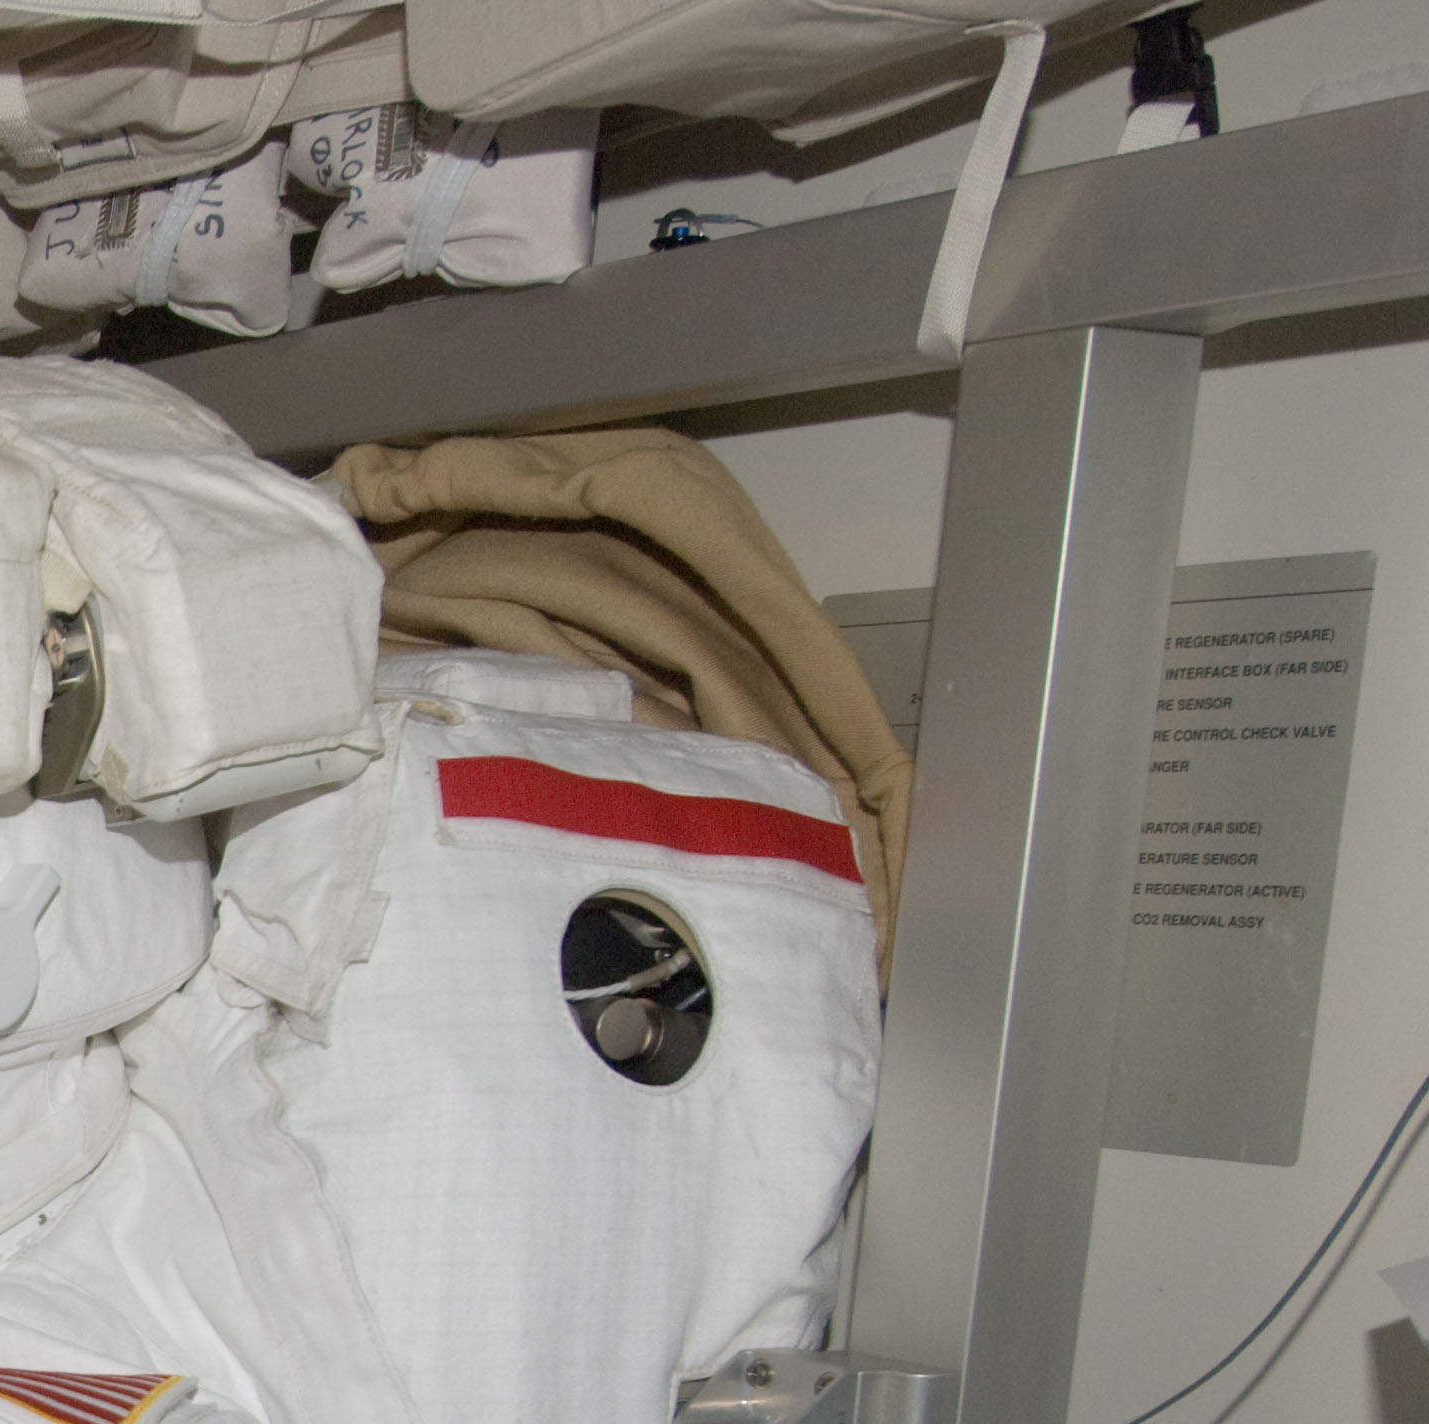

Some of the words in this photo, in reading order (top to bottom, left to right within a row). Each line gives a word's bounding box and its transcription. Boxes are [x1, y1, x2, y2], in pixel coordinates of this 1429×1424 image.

[1175, 632, 1276, 649] REGENERATOR
[1279, 628, 1335, 646] (SPARE)
[1165, 665, 1239, 680] INTERFACE
[1243, 663, 1272, 676] BOX
[1275, 662, 1307, 678] (FAR
[1311, 660, 1349, 675] SIDE)
[1177, 697, 1233, 710] SENSOR
[1173, 728, 1237, 742] CONTROL
[1241, 726, 1287, 740] CHECK
[1293, 725, 1337, 738] VALVE
[1193, 822, 1224, 836] (FAR
[1227, 822, 1261, 836] SIDE)
[1202, 853, 1259, 866] SENSOR
[1145, 884, 1243, 896] REGENERATOR
[1247, 886, 1305, 900] (ACTIVE)
[1133, 913, 1158, 926] CO2
[1162, 914, 1225, 928] REMOVAL
[1228, 916, 1265, 928] ASSY
